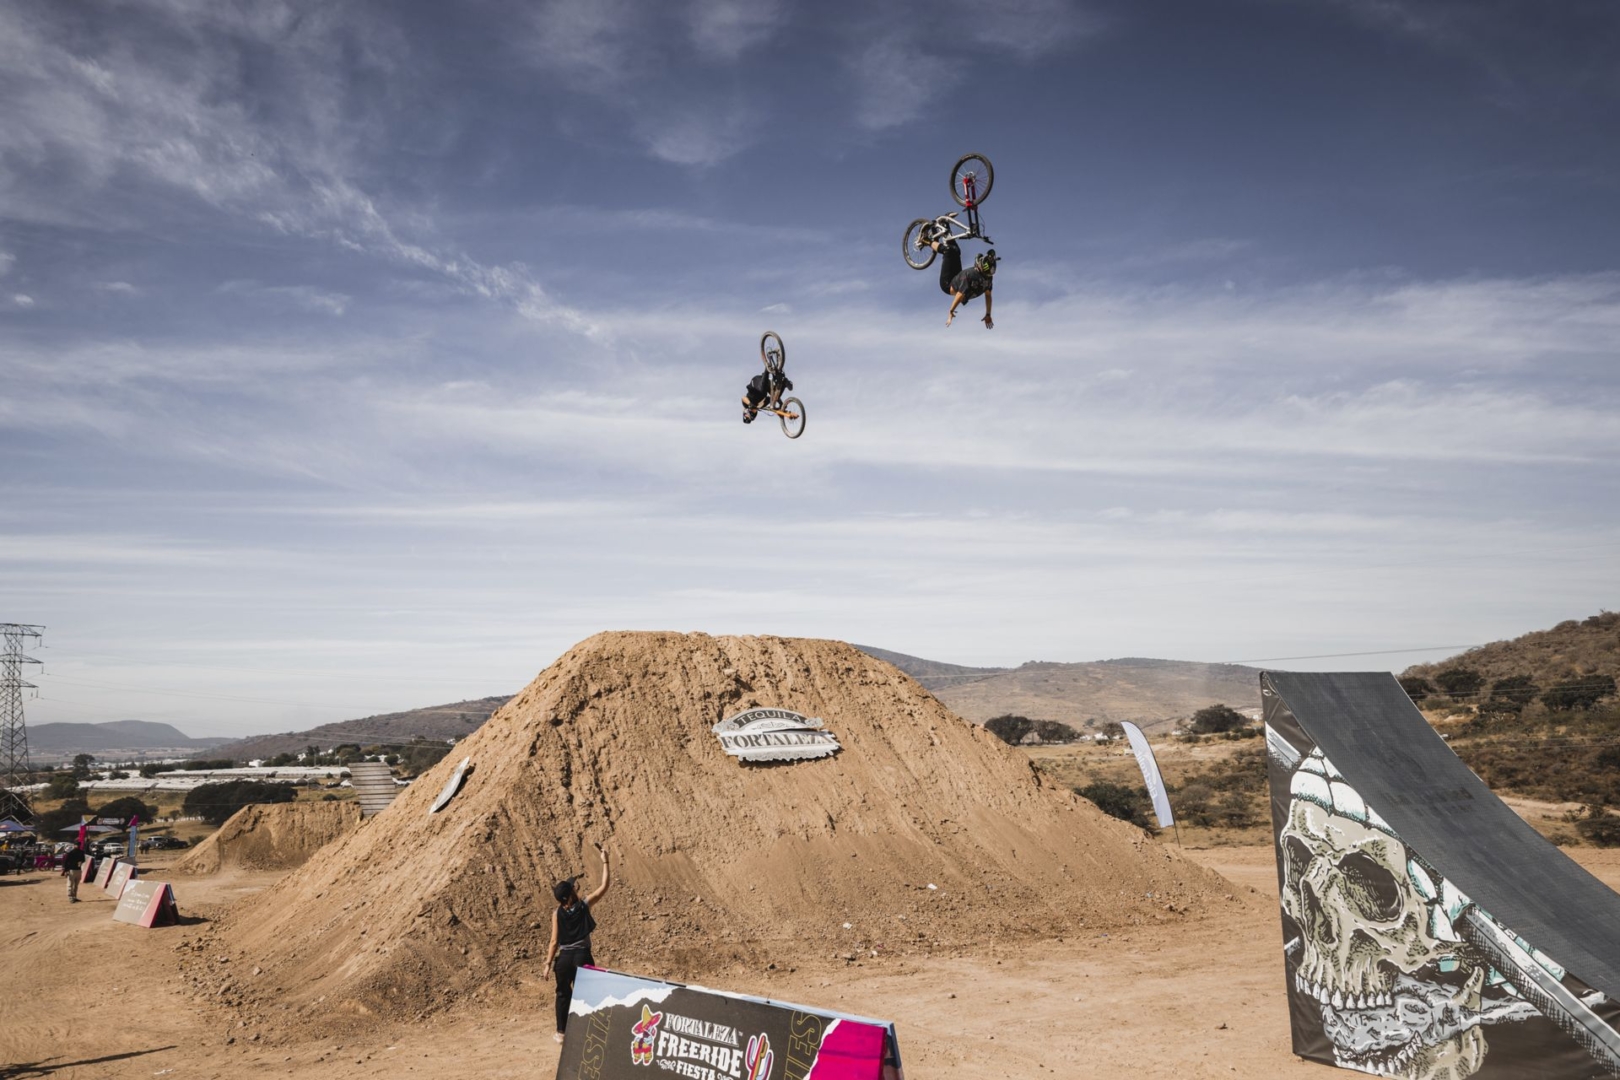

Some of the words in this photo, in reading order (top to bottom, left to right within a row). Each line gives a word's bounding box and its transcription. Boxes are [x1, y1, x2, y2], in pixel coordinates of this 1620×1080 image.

[737, 710, 802, 724] TEQUILA
[664, 1012, 739, 1047] FORTALEZA
[656, 1030, 744, 1078] FREERIDE
[675, 1060, 716, 1080] FIESTA
